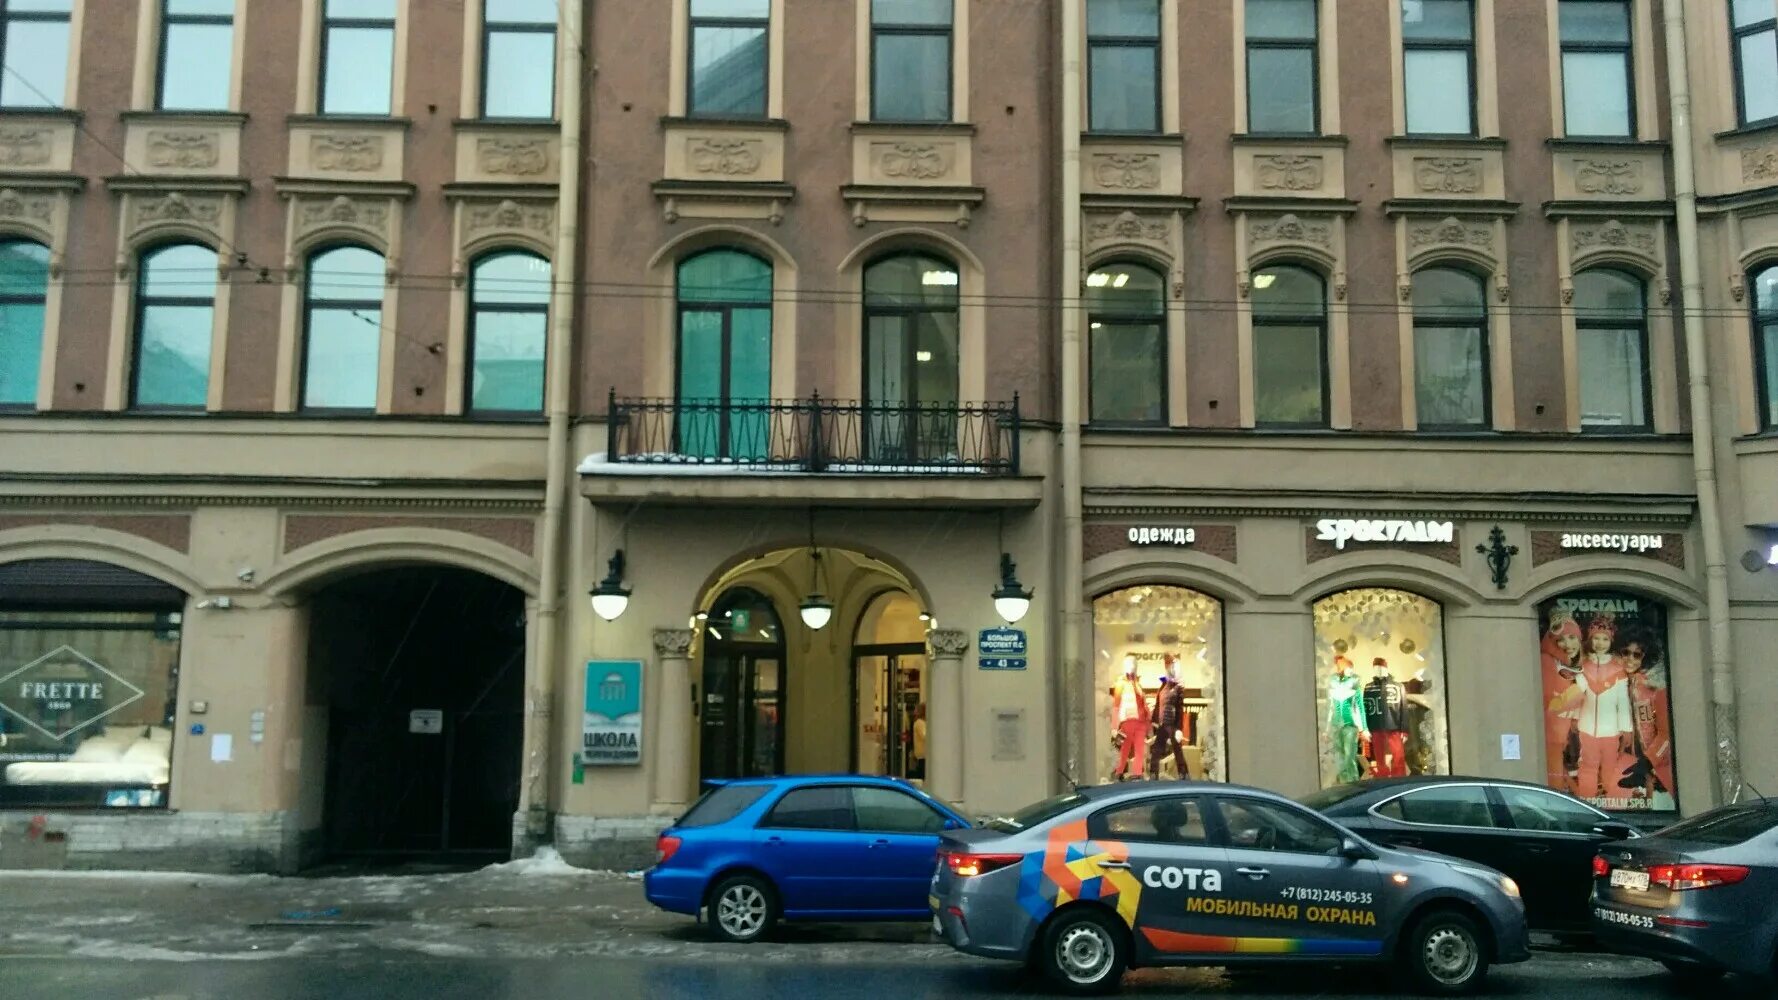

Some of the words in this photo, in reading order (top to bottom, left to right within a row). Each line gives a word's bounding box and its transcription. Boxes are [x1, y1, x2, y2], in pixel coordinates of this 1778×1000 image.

[1128, 527, 1196, 545] одежда
[1315, 519, 1454, 550] SPORTALM
[1561, 533, 1663, 553] аксессуары
[20, 682, 104, 699] FRETTE
[584, 731, 638, 747] ШКОЛА
[1280, 886, 1295, 898] +7
[1296, 887, 1322, 902] (812)
[1323, 889, 1373, 905] 245-05-35
[1186, 897, 1298, 920] МОБИЛЬНАЯ
[1306, 906, 1377, 926] ОХРАНА
[1615, 911, 1654, 928] 245-05-35
